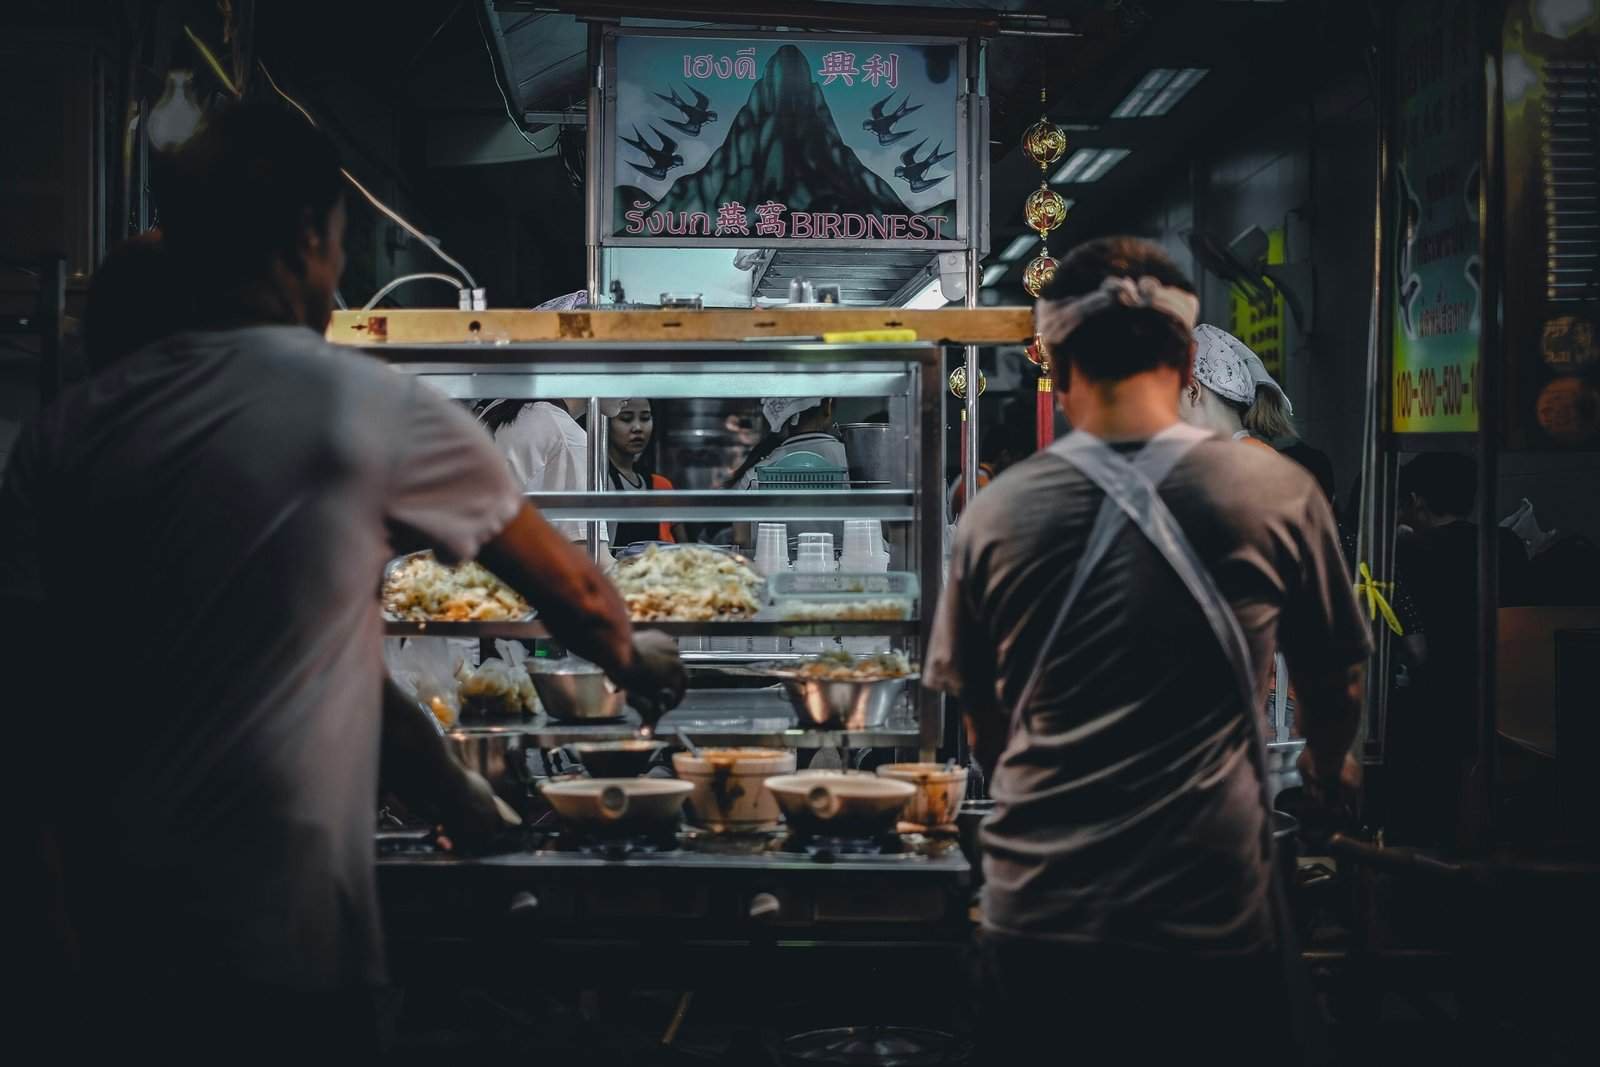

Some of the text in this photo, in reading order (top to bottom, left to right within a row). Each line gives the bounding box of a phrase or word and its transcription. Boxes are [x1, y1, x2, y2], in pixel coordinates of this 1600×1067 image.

[683, 48, 757, 80] เฮงดี
[817, 51, 899, 88] 興利
[624, 200, 949, 240] รังนก 燕窩 BIRDNEST
